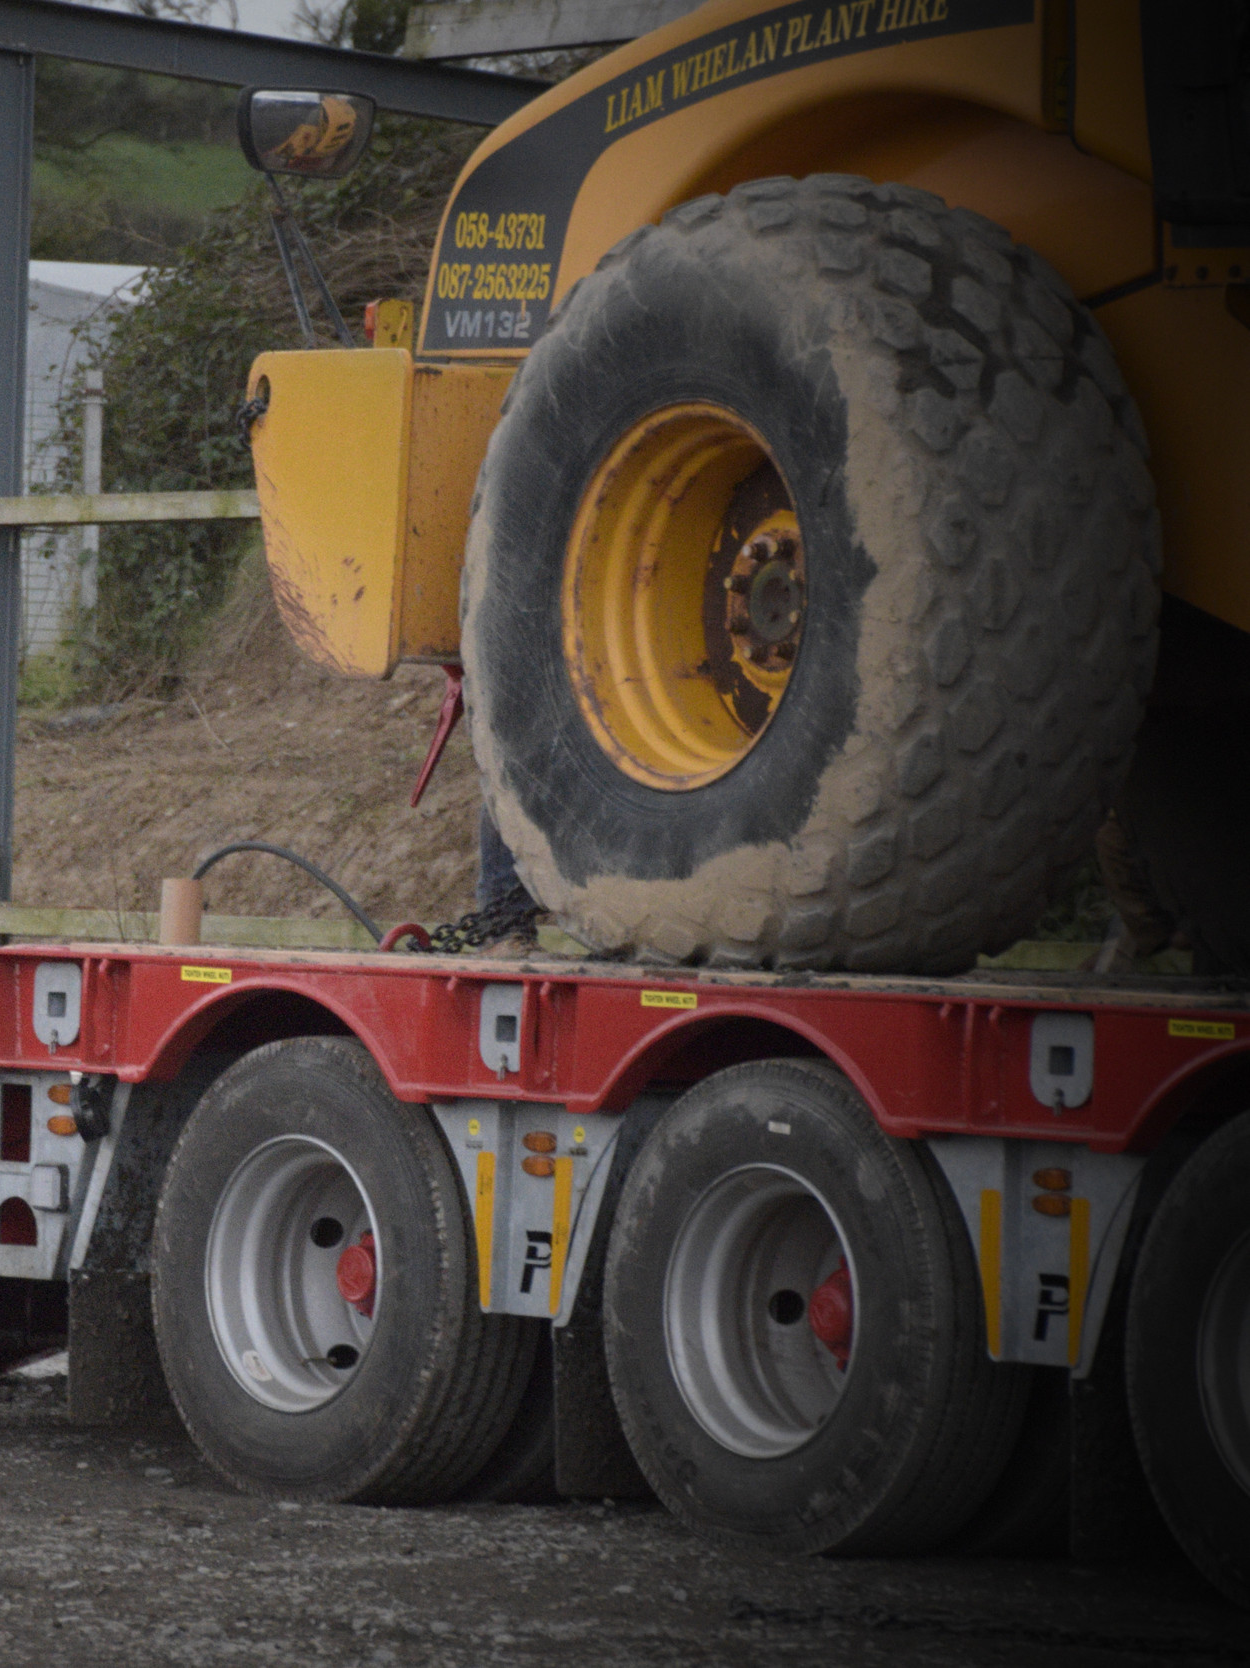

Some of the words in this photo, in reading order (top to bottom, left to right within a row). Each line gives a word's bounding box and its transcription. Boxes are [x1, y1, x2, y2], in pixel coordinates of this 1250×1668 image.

[604, 70, 666, 133] LIAM
[672, 22, 782, 100] WHELAN
[782, 2, 876, 57] PLANT
[876, 0, 949, 33] HIRE
[455, 211, 546, 250] 058-43731
[437, 263, 551, 300] 087-2563225
[445, 310, 532, 339] VM132
